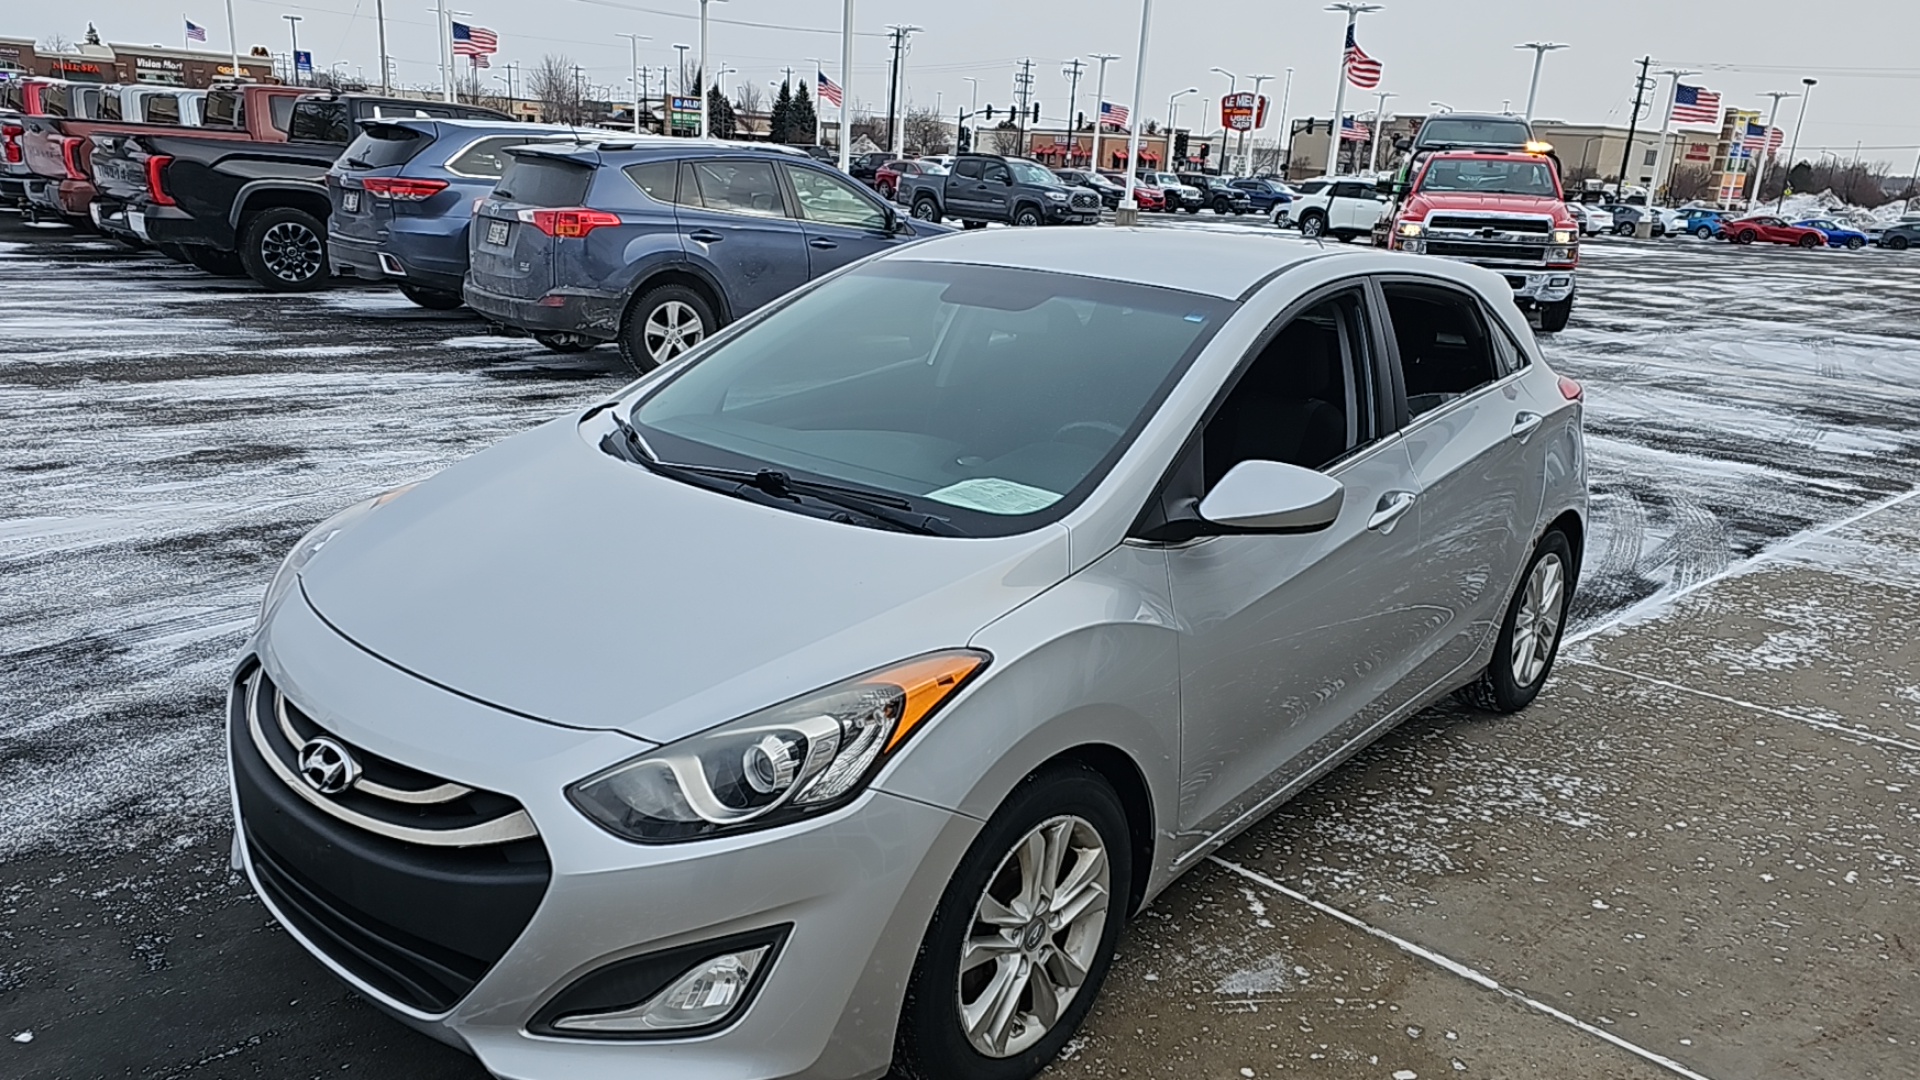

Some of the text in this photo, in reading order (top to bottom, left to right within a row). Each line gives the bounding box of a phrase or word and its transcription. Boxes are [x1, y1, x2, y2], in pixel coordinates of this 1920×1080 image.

[80, 63, 100, 73] SPA
[136, 57, 183, 71] Vision Mart
[1224, 96, 1235, 108] LE
